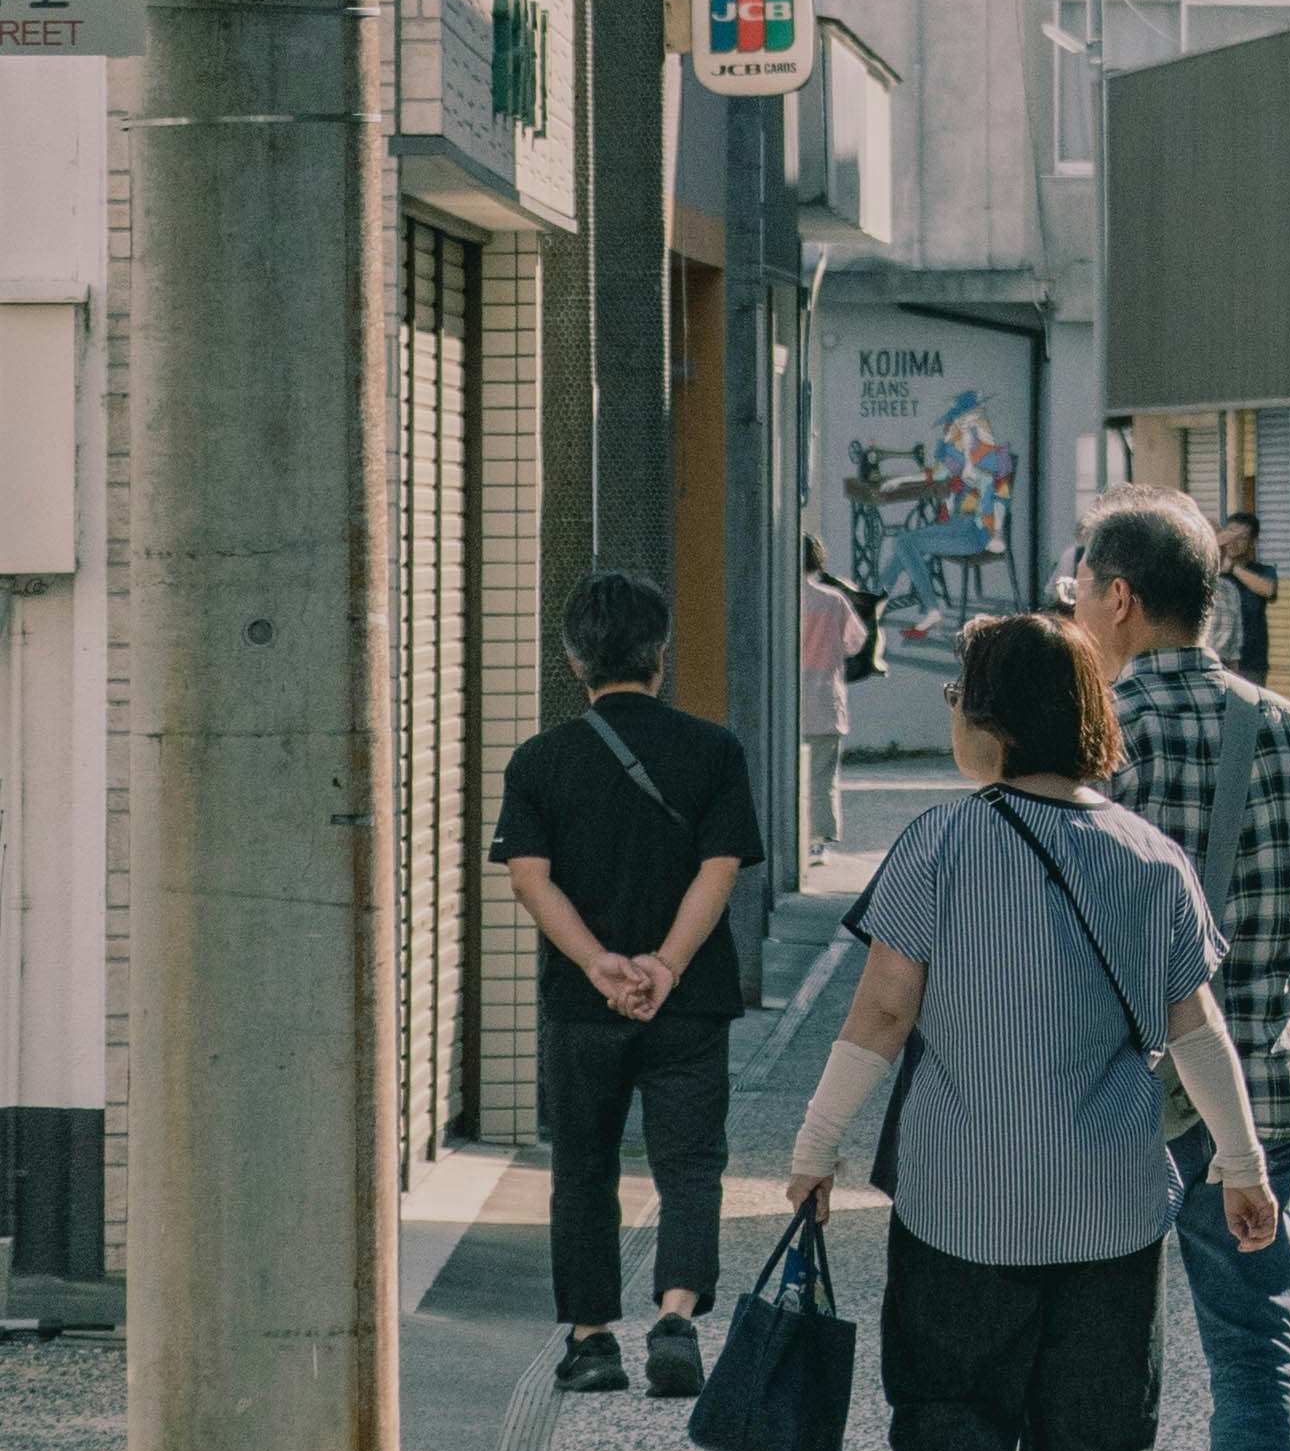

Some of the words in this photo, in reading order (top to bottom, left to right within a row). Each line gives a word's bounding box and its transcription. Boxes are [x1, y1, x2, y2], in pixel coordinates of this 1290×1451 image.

[712, 1, 792, 21] JCB
[711, 63, 762, 76] JCB
[764, 62, 797, 75] CARDS
[859, 350, 943, 377] KOJIMA
[860, 381, 909, 397] JEANS
[859, 400, 919, 417] STREET
